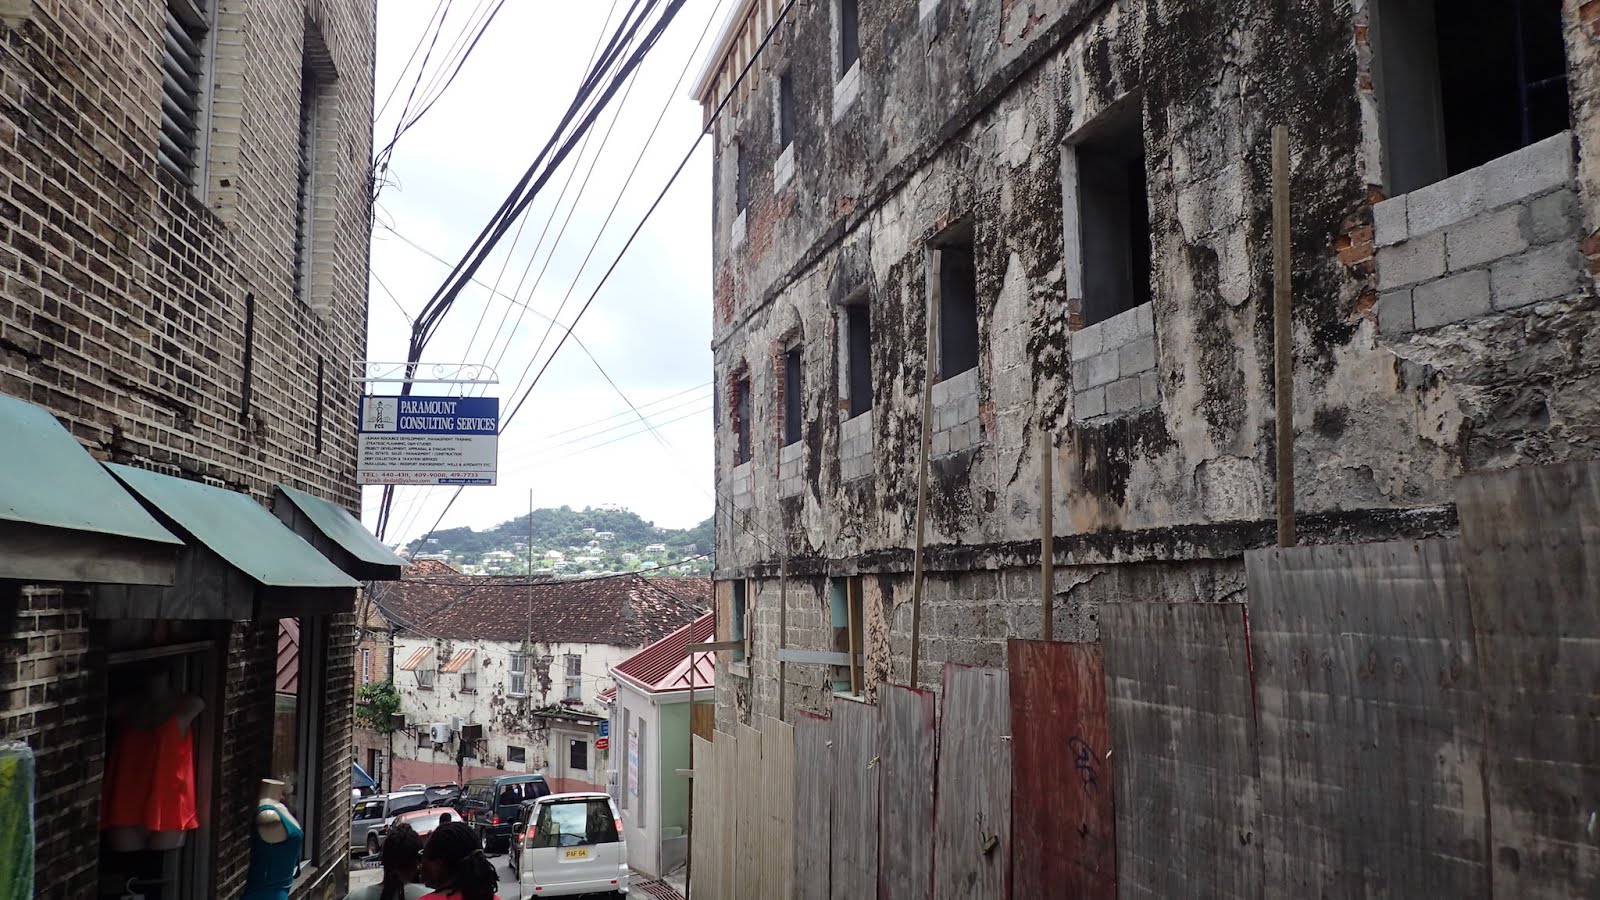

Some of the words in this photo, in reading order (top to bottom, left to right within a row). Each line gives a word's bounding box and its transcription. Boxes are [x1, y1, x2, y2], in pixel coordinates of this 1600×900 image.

[400, 401, 457, 414] PARAMOUNT
[400, 416, 454, 430] CONSULTING
[456, 418, 496, 431] SERVICES
